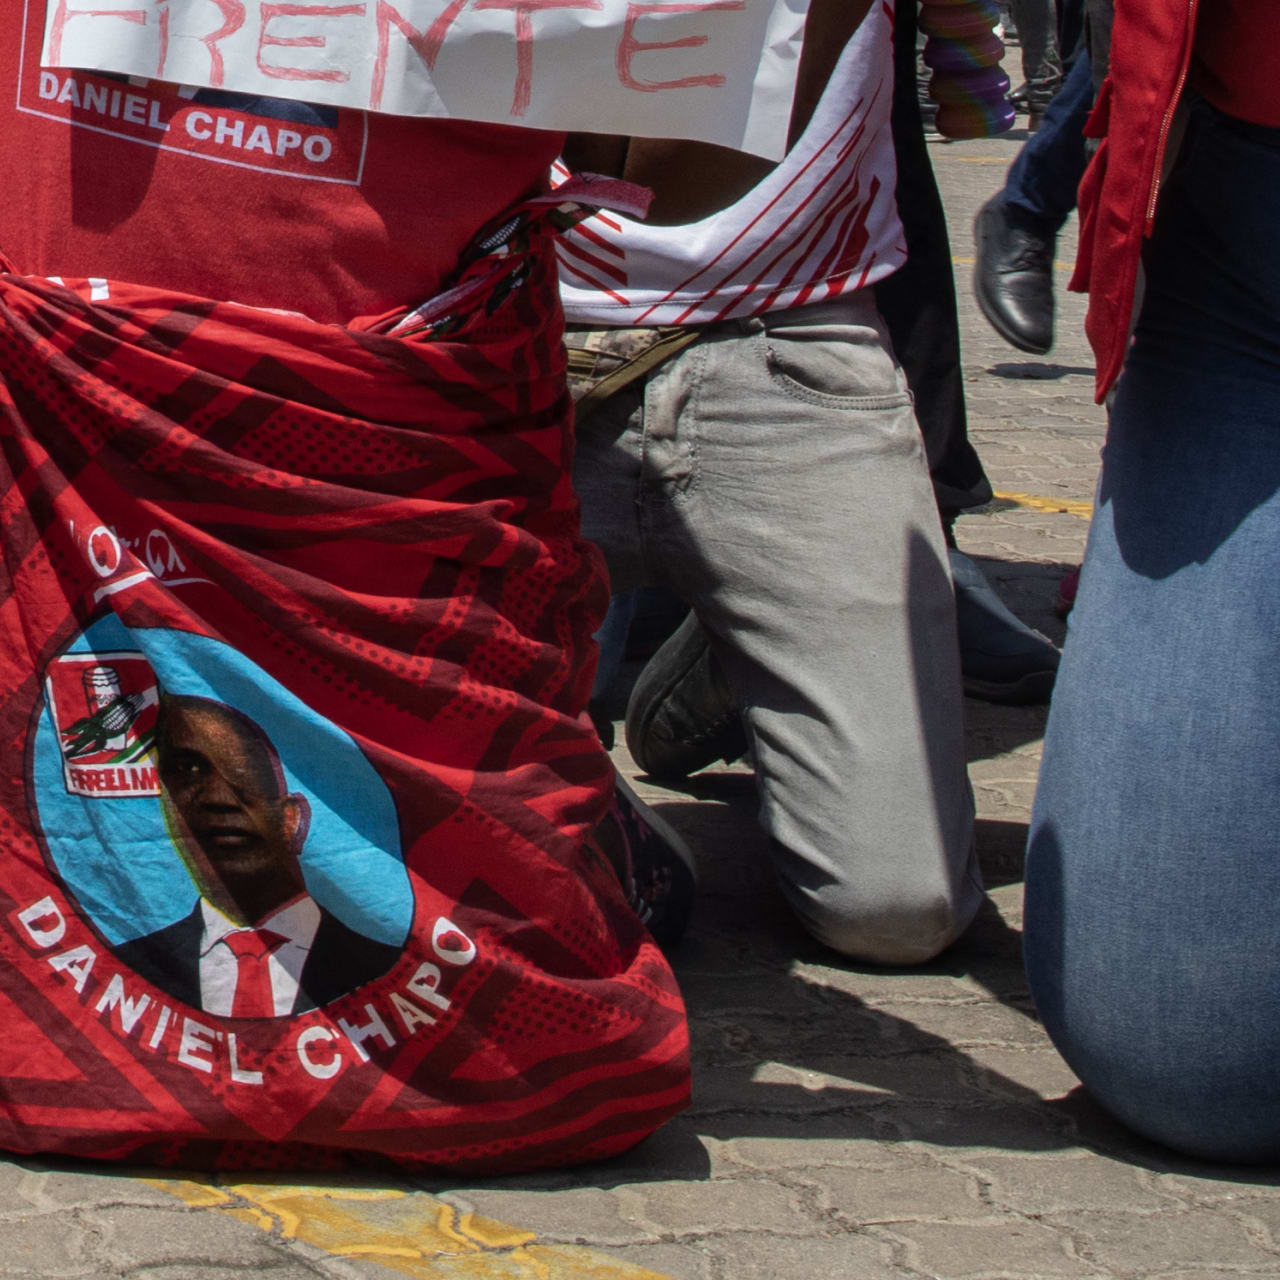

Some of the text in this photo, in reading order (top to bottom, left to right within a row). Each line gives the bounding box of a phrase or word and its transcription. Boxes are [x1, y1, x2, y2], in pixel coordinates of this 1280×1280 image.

[40, 70, 333, 164] DANIEL CHAPO
[18, 895, 477, 1085] DANIEL CHAPO
